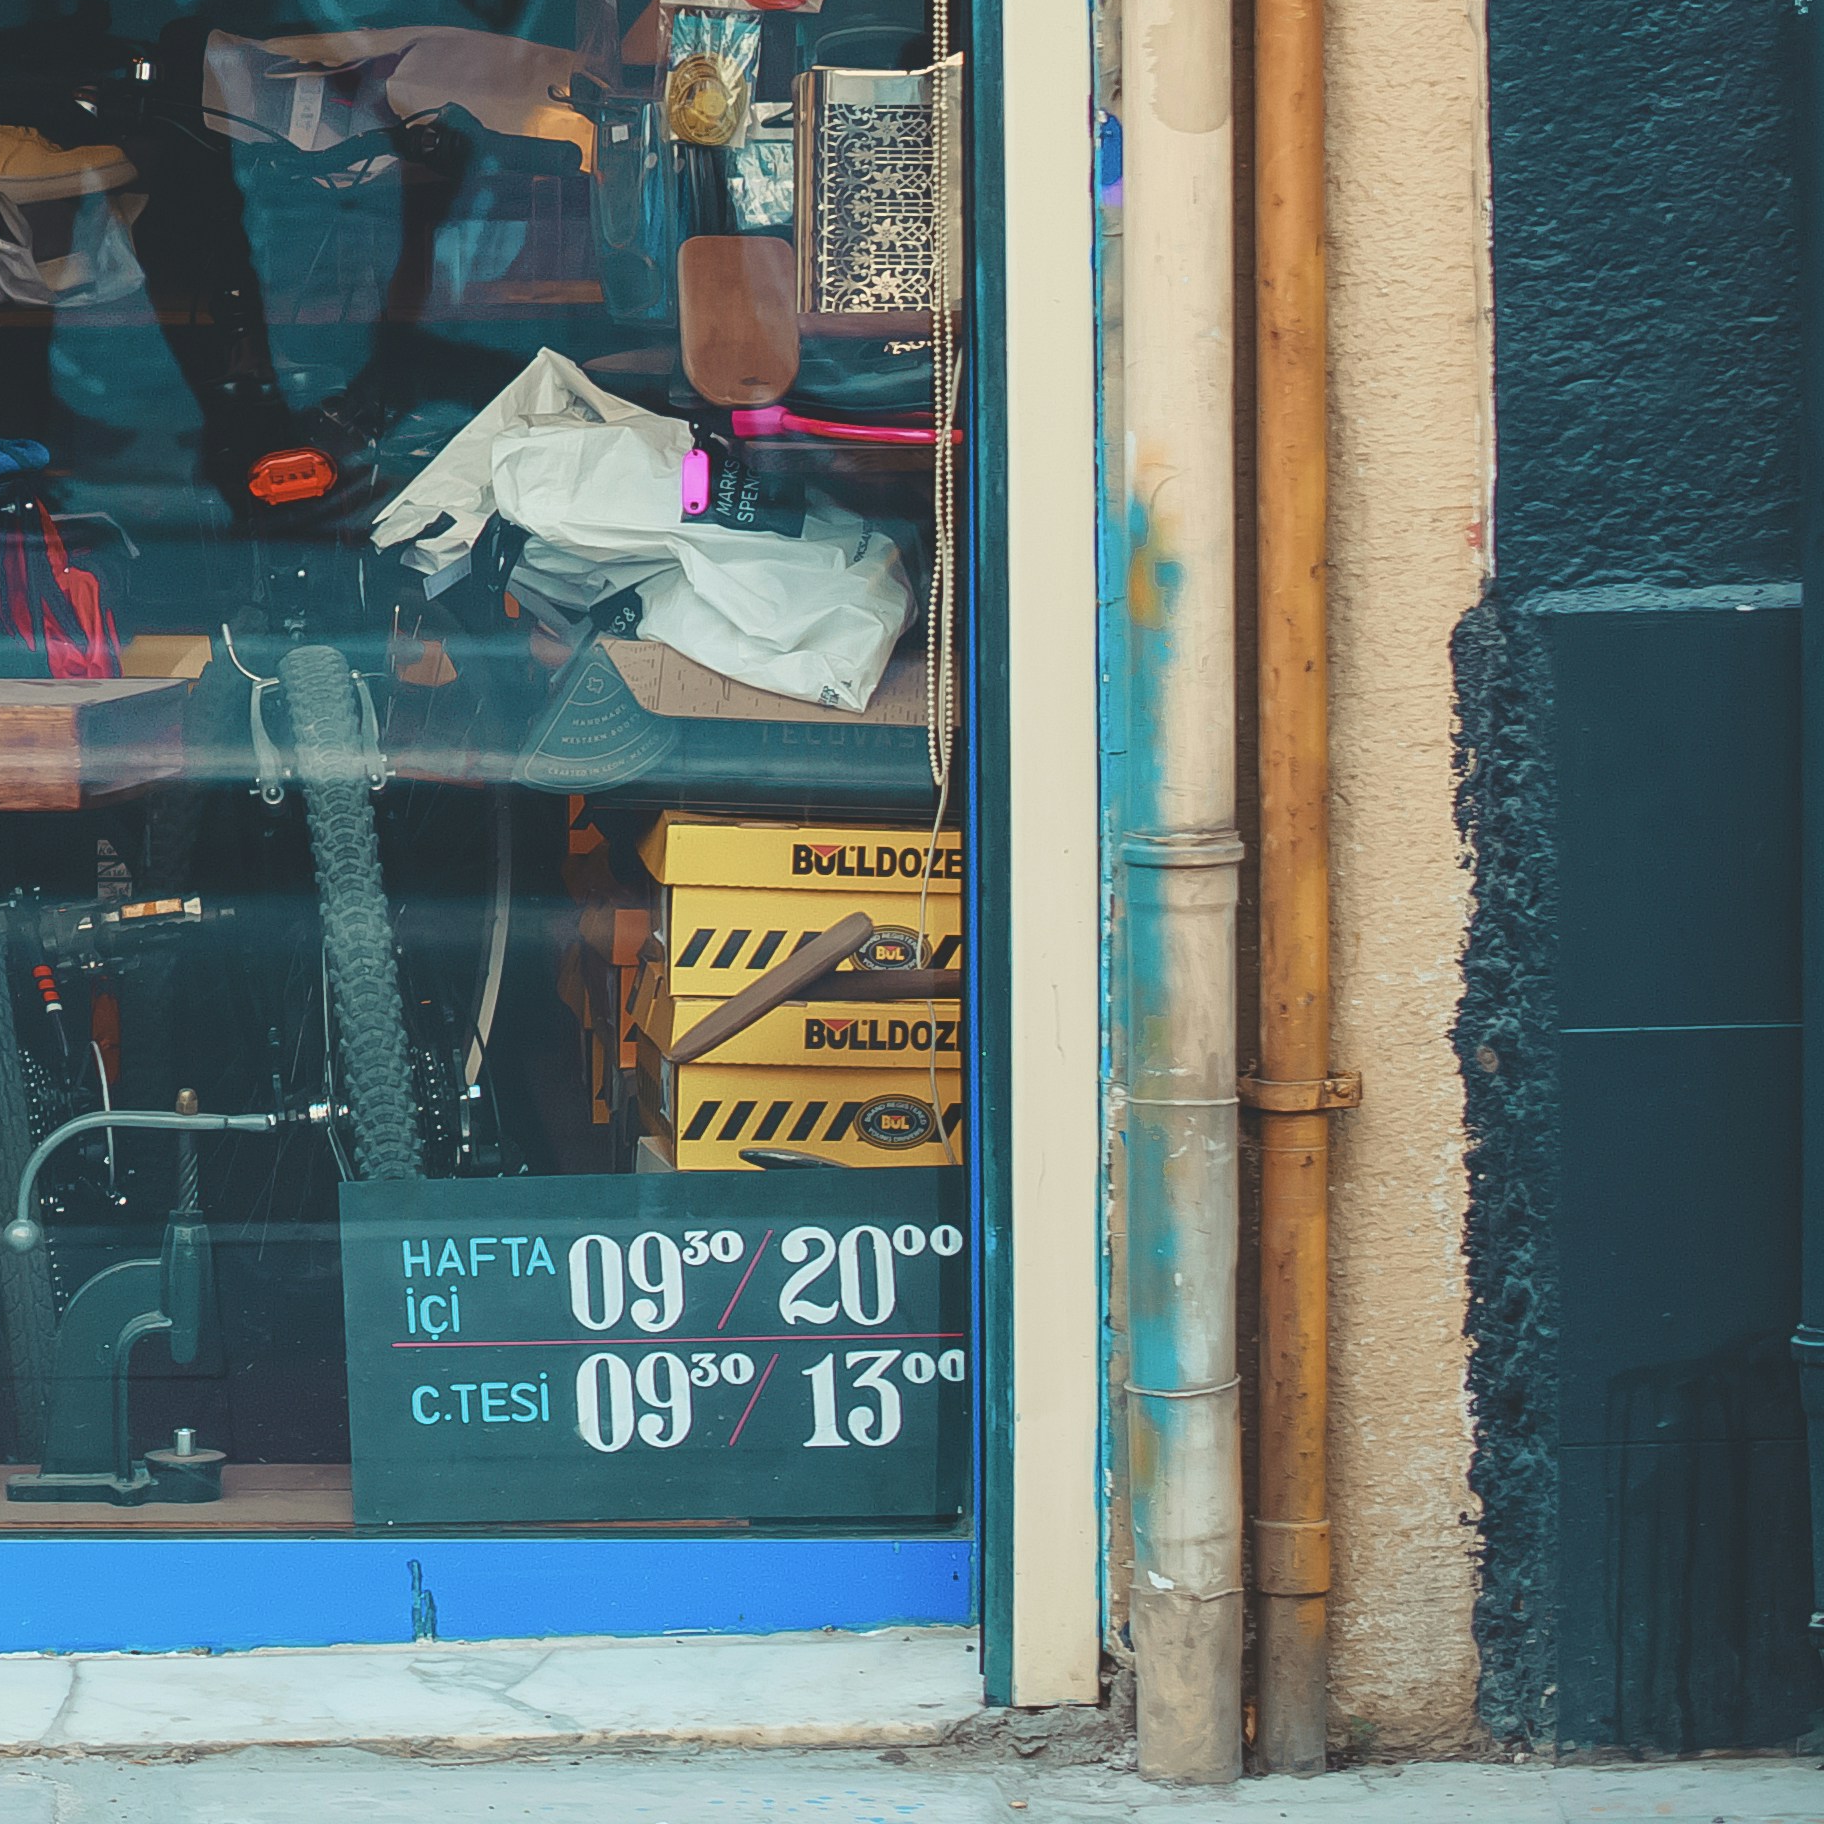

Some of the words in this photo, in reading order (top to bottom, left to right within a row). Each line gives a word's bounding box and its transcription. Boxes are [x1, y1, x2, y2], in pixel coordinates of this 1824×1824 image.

[715, 459, 740, 516] MARKS
[875, 945, 905, 961] BUL
[804, 1018, 962, 1052] BULLDOZ
[881, 1114, 910, 1130] BUL
[402, 1236, 556, 1278] HAFTA
[405, 1285, 461, 1341] İÇİ
[411, 1372, 551, 1425] C.TESİ
